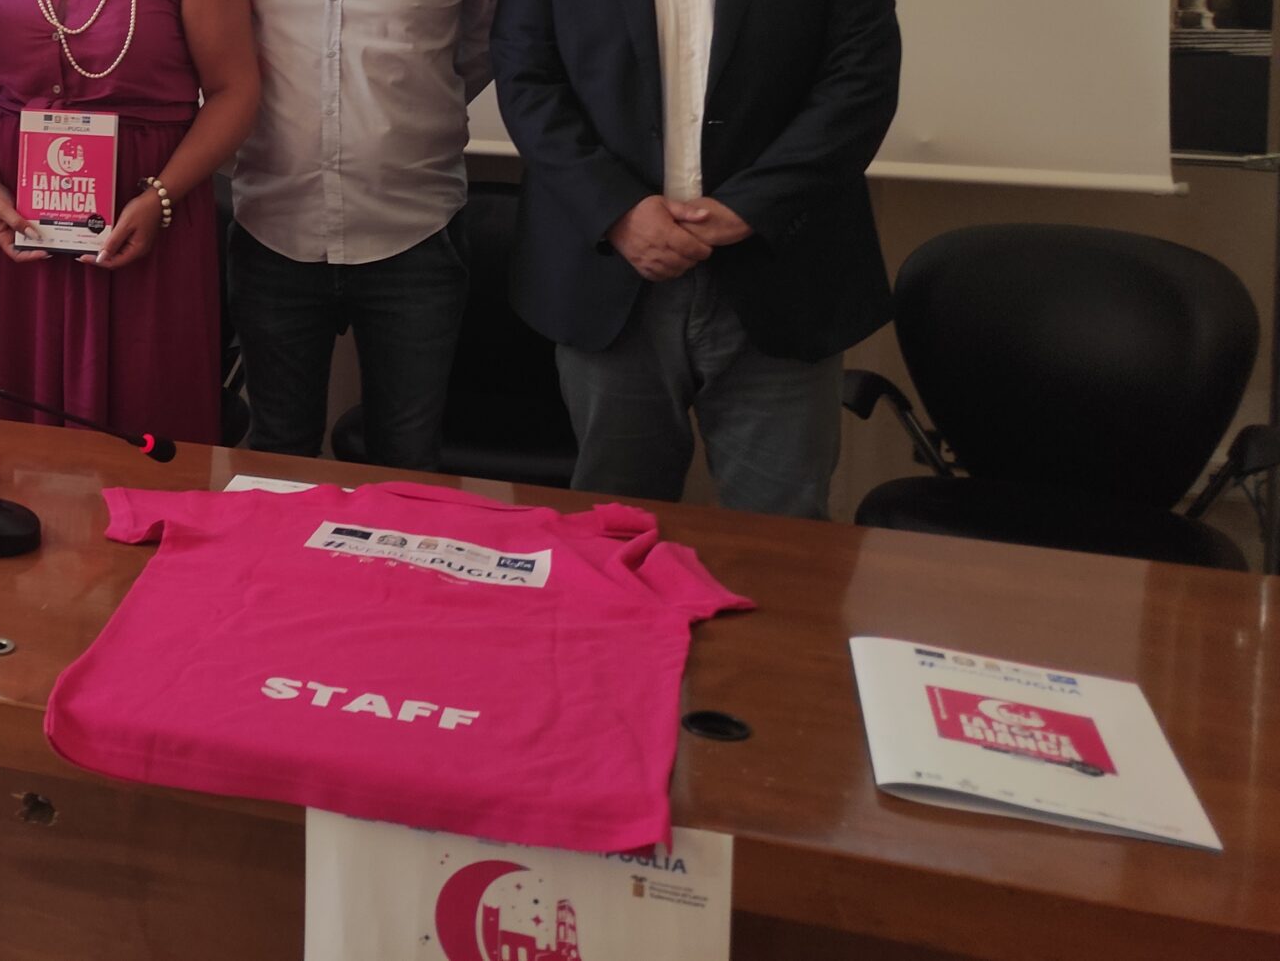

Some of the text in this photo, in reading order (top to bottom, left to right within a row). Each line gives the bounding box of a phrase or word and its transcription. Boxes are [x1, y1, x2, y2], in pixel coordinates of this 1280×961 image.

[32, 174, 49, 190] LA
[31, 190, 97, 213] BIANCA
[261, 676, 481, 730] STAFF
